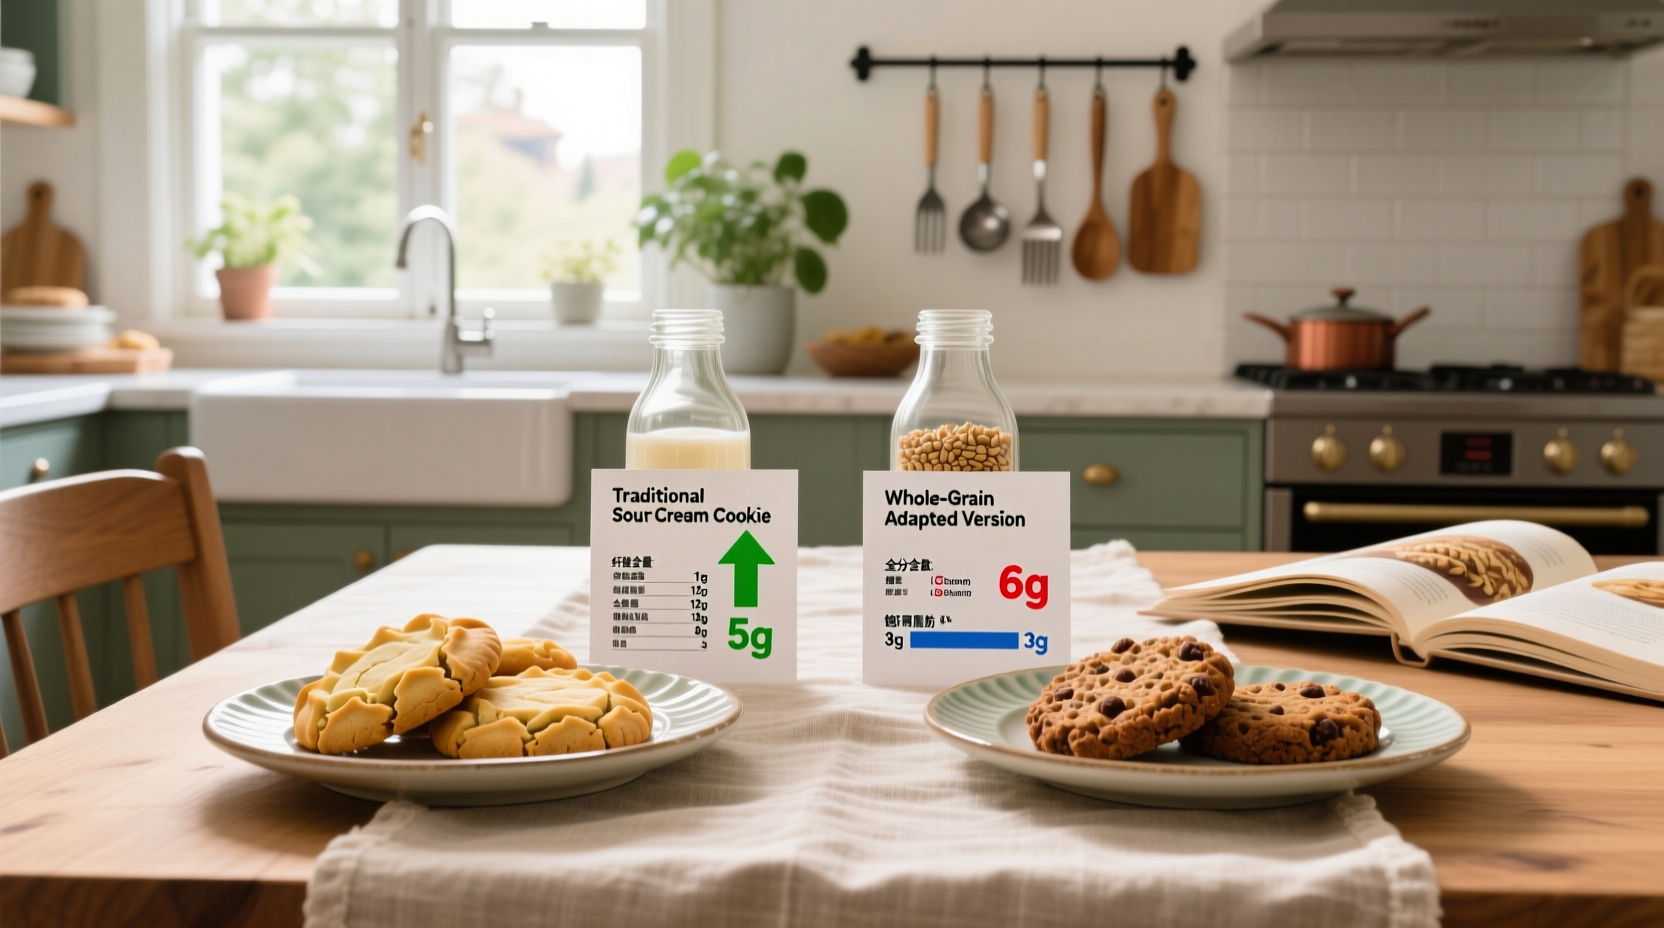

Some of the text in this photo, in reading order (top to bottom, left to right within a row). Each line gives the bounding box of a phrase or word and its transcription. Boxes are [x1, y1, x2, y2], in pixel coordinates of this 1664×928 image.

[612, 487, 705, 504] Traditional
[885, 489, 995, 507] Whole-Grain
[612, 506, 772, 524] Sour Cream Cookie
[884, 510, 1026, 530] Adapted Version
[998, 564, 1049, 611] 6g
[727, 616, 773, 660] 5g
[885, 631, 904, 651] 3g
[1024, 632, 1049, 656] 3g
